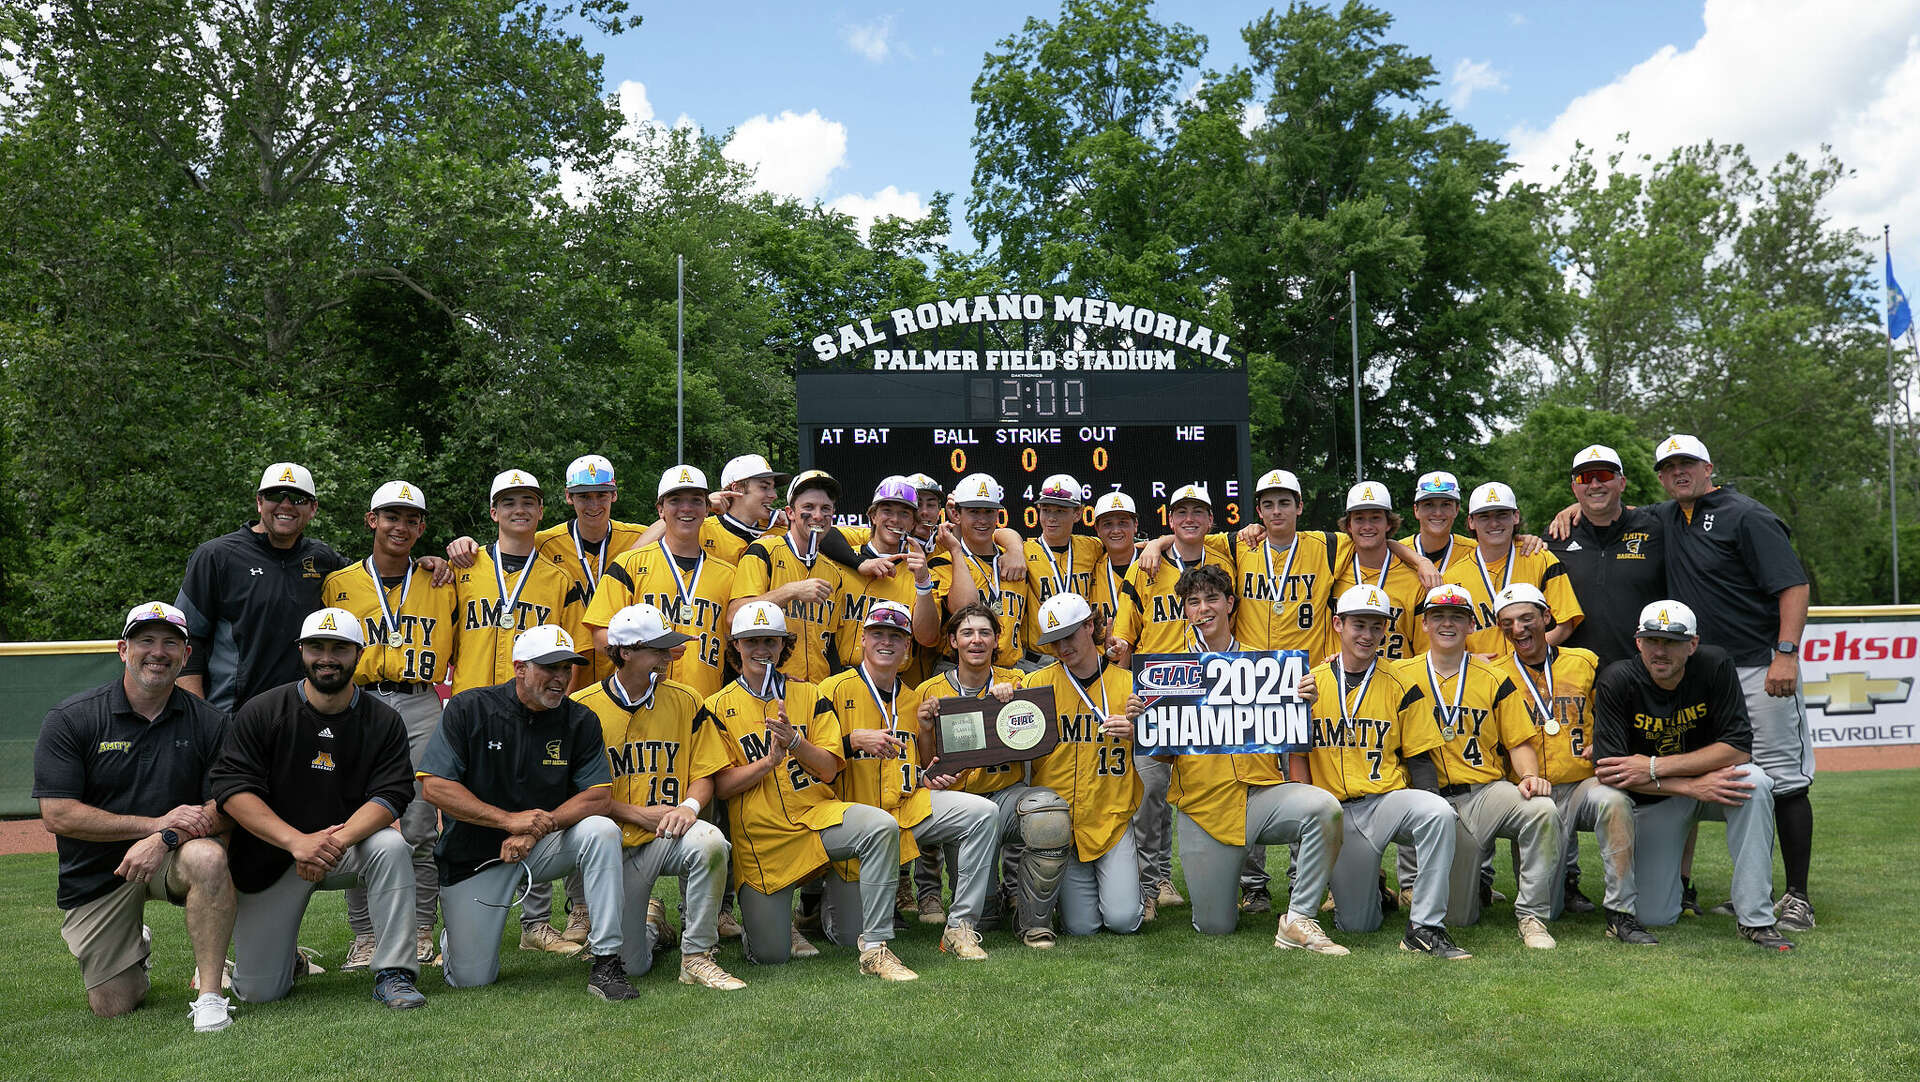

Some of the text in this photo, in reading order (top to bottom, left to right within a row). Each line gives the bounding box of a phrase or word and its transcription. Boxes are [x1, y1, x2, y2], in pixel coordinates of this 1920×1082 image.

[812, 294, 1232, 363] SAL ROMANO MEMORIAL
[874, 349, 1176, 371] PALMER FIELD STADIUM
[1001, 380, 1085, 416] 2:00
[820, 425, 1205, 444] AT BAT BALL STRIKE OUT H/E
[1588, 448, 1601, 459] A
[1667, 439, 1681, 452] A
[950, 447, 1109, 473] 0 0 0
[279, 467, 296, 483] A
[509, 472, 523, 485] A
[679, 468, 694, 483] A
[1268, 472, 1282, 485] A
[398, 485, 413, 500] A
[977, 482, 990, 497] A
[1022, 485, 1034, 500] 4
[1152, 482, 1166, 497] R
[1226, 481, 1239, 496] E
[1185, 487, 1196, 498] A
[1362, 487, 1375, 501] A
[1486, 488, 1500, 502] A
[1112, 496, 1124, 508] A
[831, 514, 872, 527] TAPL
[1024, 506, 1038, 528] 0
[1082, 505, 1096, 526] 0
[1156, 504, 1167, 526] 1
[1226, 503, 1240, 525] 3
[1243, 572, 1316, 602] AMTY
[1367, 590, 1380, 606] A
[319, 613, 336, 631] A
[465, 598, 551, 631] AMTY
[754, 608, 768, 625] A
[1047, 610, 1060, 629] A
[1298, 603, 1314, 630] 8
[1658, 609, 1669, 625] A
[364, 615, 436, 647] MTY
[555, 630, 571, 647] A
[698, 632, 721, 669] 12
[1803, 630, 1918, 662] ckso
[403, 648, 436, 681] 18
[1148, 665, 1202, 686] CIAC
[1206, 656, 1304, 706] 2024
[1137, 703, 1308, 748] CHAMPION
[1809, 724, 1915, 743] HEVROLET
[1462, 736, 1483, 767] 4
[1570, 727, 1584, 757] 2
[607, 741, 680, 777] MITY
[1098, 746, 1126, 777] 13
[1366, 750, 1384, 780] 7
[647, 777, 680, 806] 19
